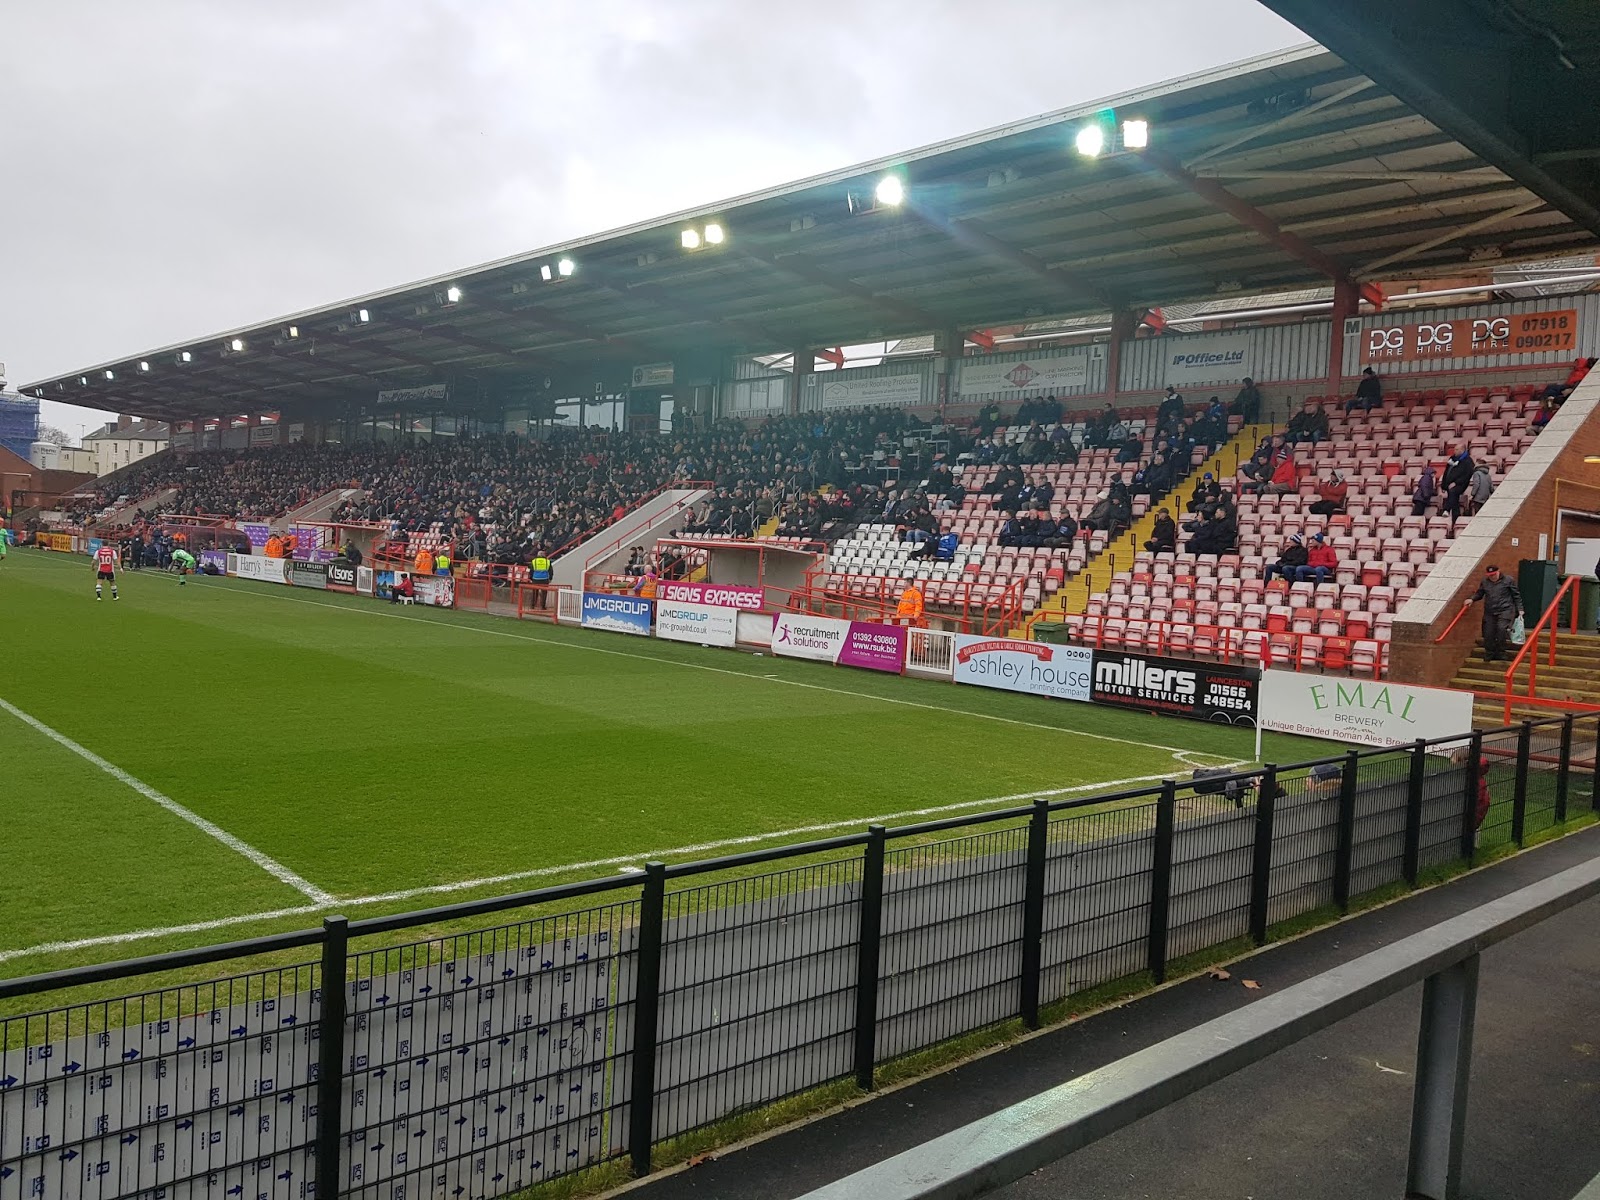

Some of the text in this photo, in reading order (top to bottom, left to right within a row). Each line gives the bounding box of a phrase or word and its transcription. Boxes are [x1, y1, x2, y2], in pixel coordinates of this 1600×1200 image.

[1346, 321, 1360, 334] M
[1472, 318, 1509, 341] DG
[1521, 316, 1568, 331] 07918
[1370, 328, 1404, 350] DG
[1417, 323, 1453, 346] DG
[1515, 333, 1572, 348] 090217
[1416, 344, 1452, 354] HIRE
[1471, 340, 1509, 349] HIRE
[1094, 347, 1101, 358] L
[1224, 350, 1244, 361] Ltd
[1369, 348, 1403, 357] HIRE
[808, 375, 815, 385] K
[100, 555, 111, 565] 10
[240, 556, 261, 576] Harry's
[666, 585, 762, 609] SIGNS EXPRESS
[584, 598, 649, 615] JMCGROUP
[660, 609, 709, 622] JMCGROUP
[660, 621, 707, 634] jmc-groupltd.co.uk
[794, 627, 840, 640] recruitment
[794, 637, 828, 650] solutions
[853, 632, 897, 645] 01392 430800
[852, 642, 896, 654] www.rsuk.biz
[969, 654, 1090, 688] ashley house
[1096, 658, 1196, 695] millers
[1206, 676, 1253, 688] LAUNCESTON
[1030, 683, 1088, 698] printing company
[1095, 683, 1195, 704] MOTOR SERVICES
[1210, 684, 1247, 698] 01566
[1203, 695, 1251, 711] 248554
[1309, 682, 1417, 724] EMAL
[1335, 713, 1385, 728] BREWERY
[1267, 720, 1294, 731] Unique
[1296, 723, 1330, 736] Branded
[1332, 729, 1363, 741] Roman
[1364, 734, 1383, 744] Ales
